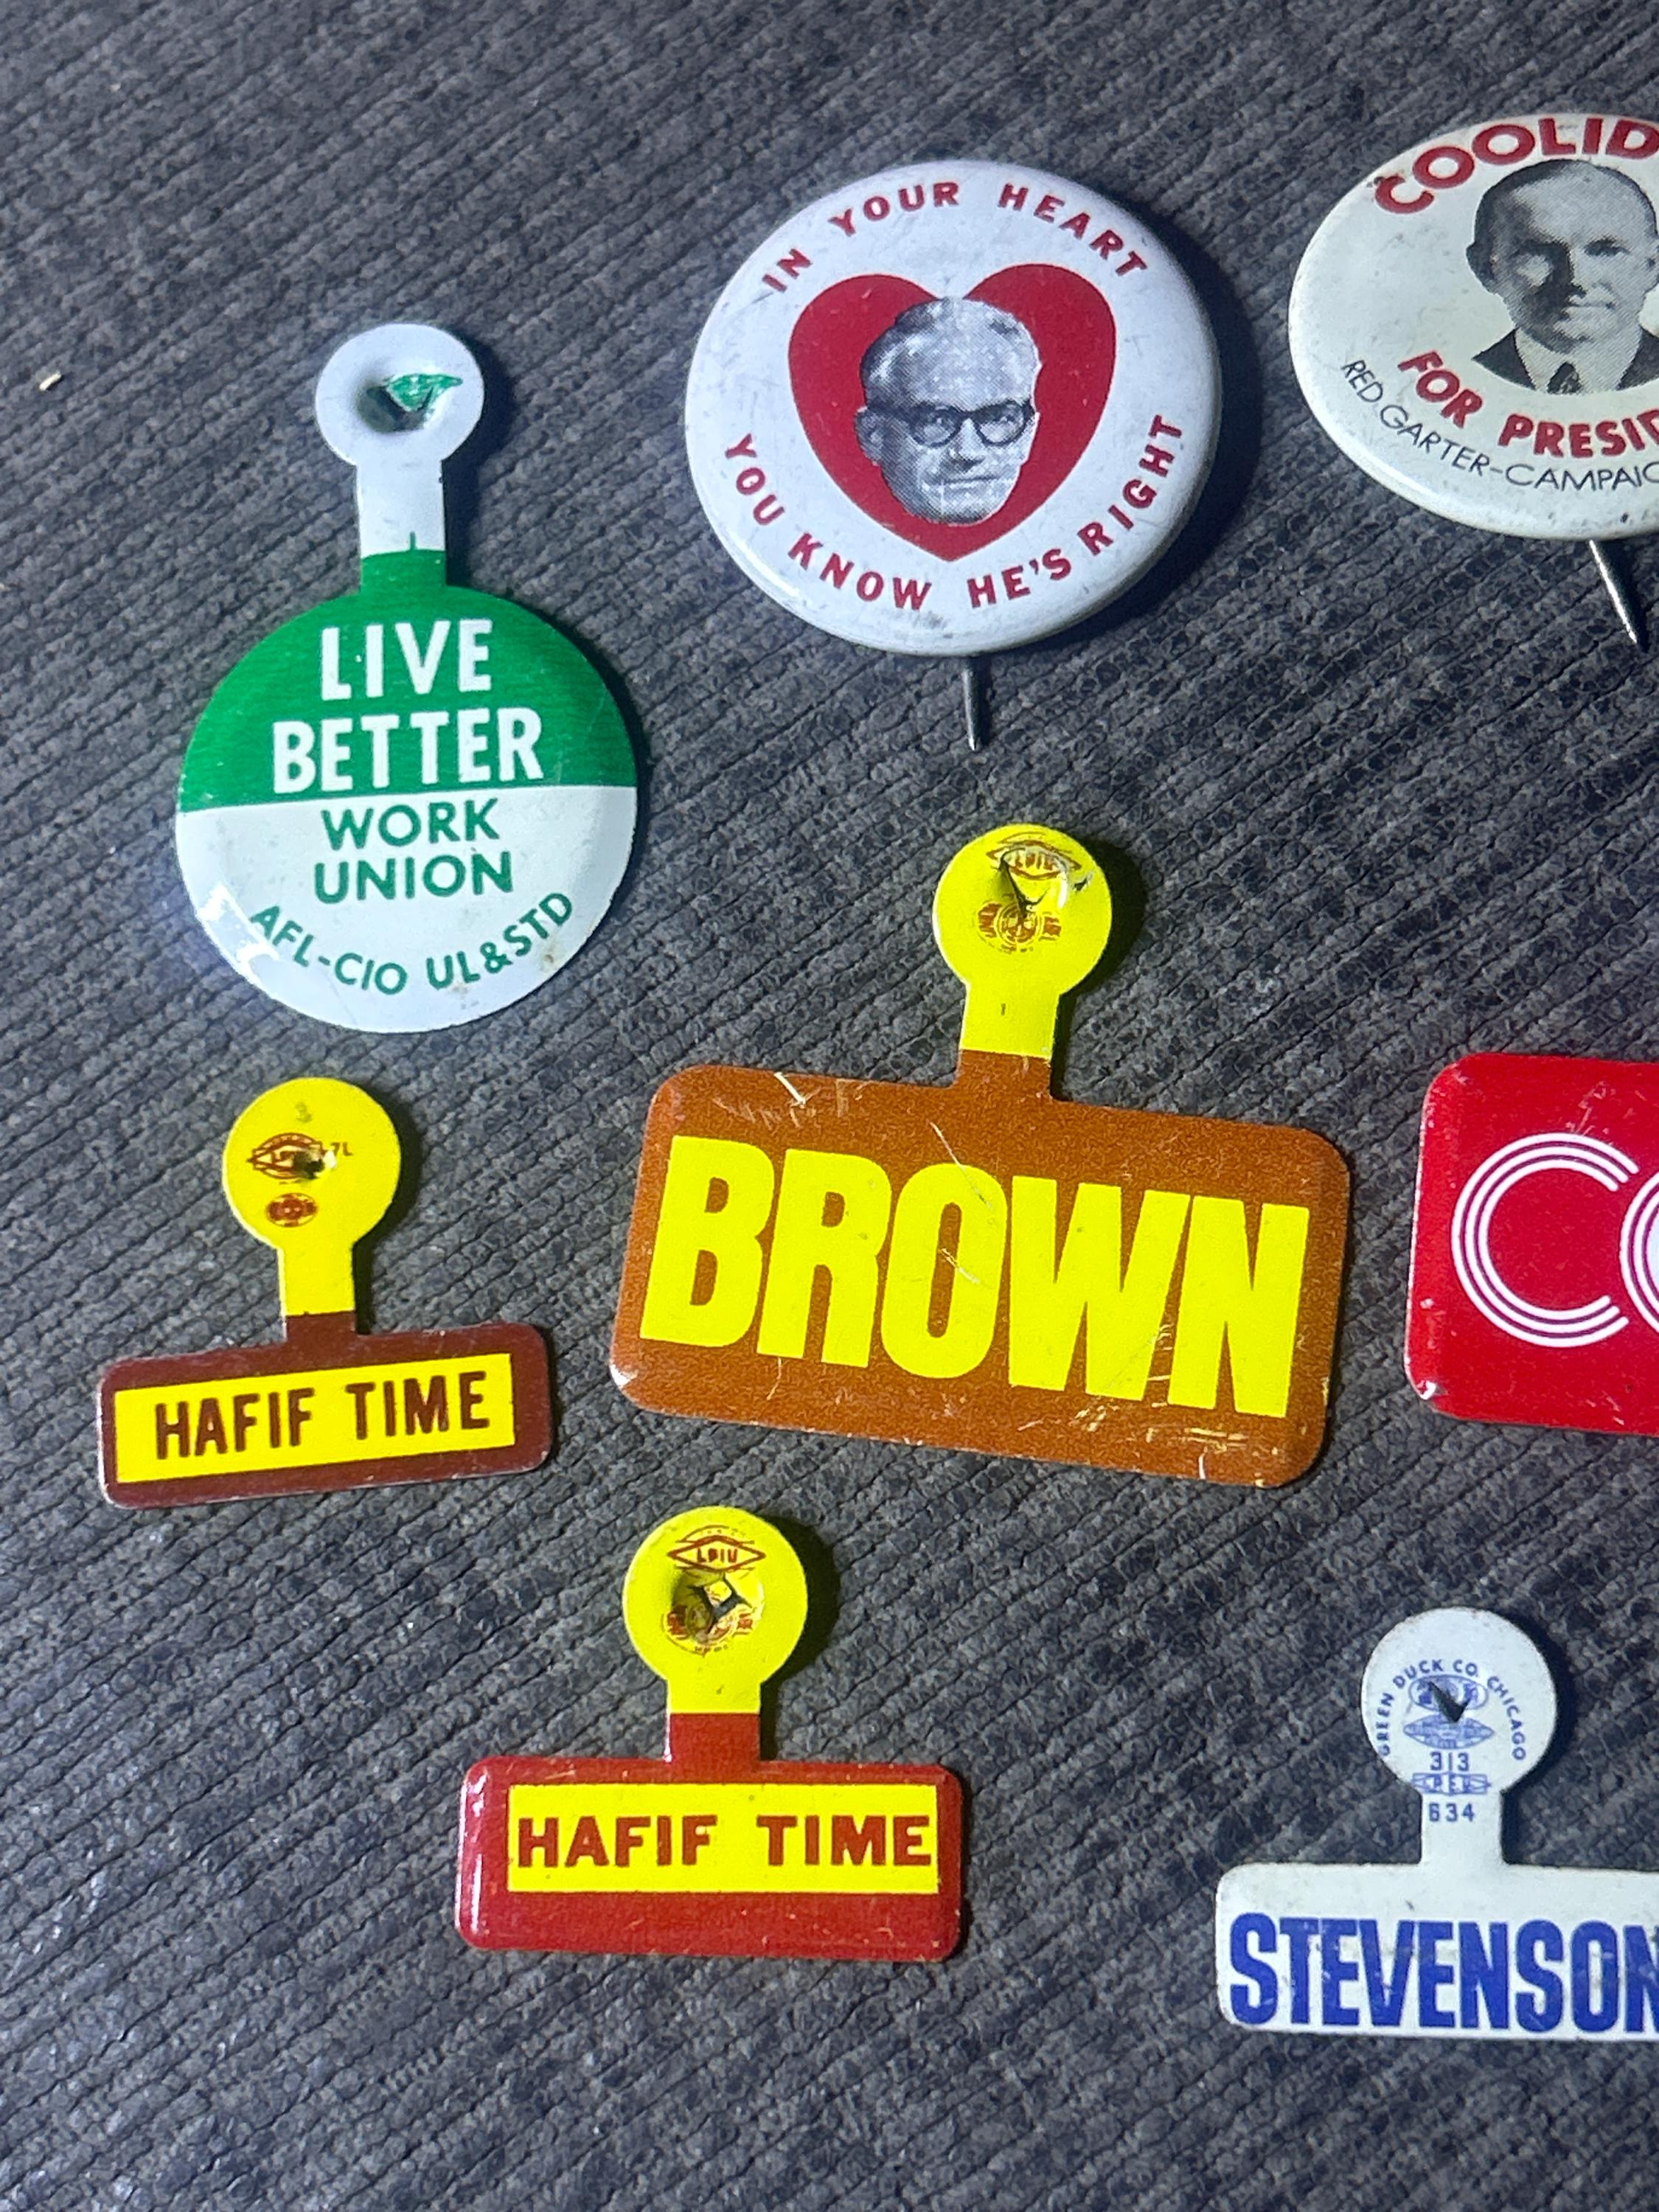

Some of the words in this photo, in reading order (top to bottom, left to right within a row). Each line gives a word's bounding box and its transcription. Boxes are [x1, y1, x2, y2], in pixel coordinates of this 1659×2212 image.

[1374, 117, 1659, 215] COOLID
[762, 248, 812, 292] IN
[829, 181, 959, 237] YOUR
[998, 183, 1147, 277] HEART
[1340, 359, 1384, 403] RED
[1397, 350, 1484, 428] FOR
[725, 434, 785, 526] YOU
[787, 532, 932, 611] KNOW
[967, 549, 1072, 609] HE'S
[1077, 414, 1183, 556] RIGHT
[321, 619, 493, 701] LIVE
[272, 707, 544, 794] BETTER
[321, 798, 499, 851] WORK
[314, 851, 514, 904] UNION
[249, 905, 408, 995] AFL-CIO
[639, 1135, 1310, 1419] BROWN
[1450, 1132, 1659, 1349] C
[154, 1388, 316, 1460] HAFIF
[346, 1371, 490, 1441] TIME
[1376, 1692, 1395, 1757] GREEN
[1392, 1659, 1444, 1689] DUCK
[1486, 1675, 1526, 1761] CHICAGO
[1429, 1751, 1470, 1771] 313
[517, 1815, 718, 1868] HAFIF
[757, 1814, 932, 1867] TIME
[1428, 1802, 1475, 1822] 634
[1230, 1912, 1659, 2033] STEVENSON
